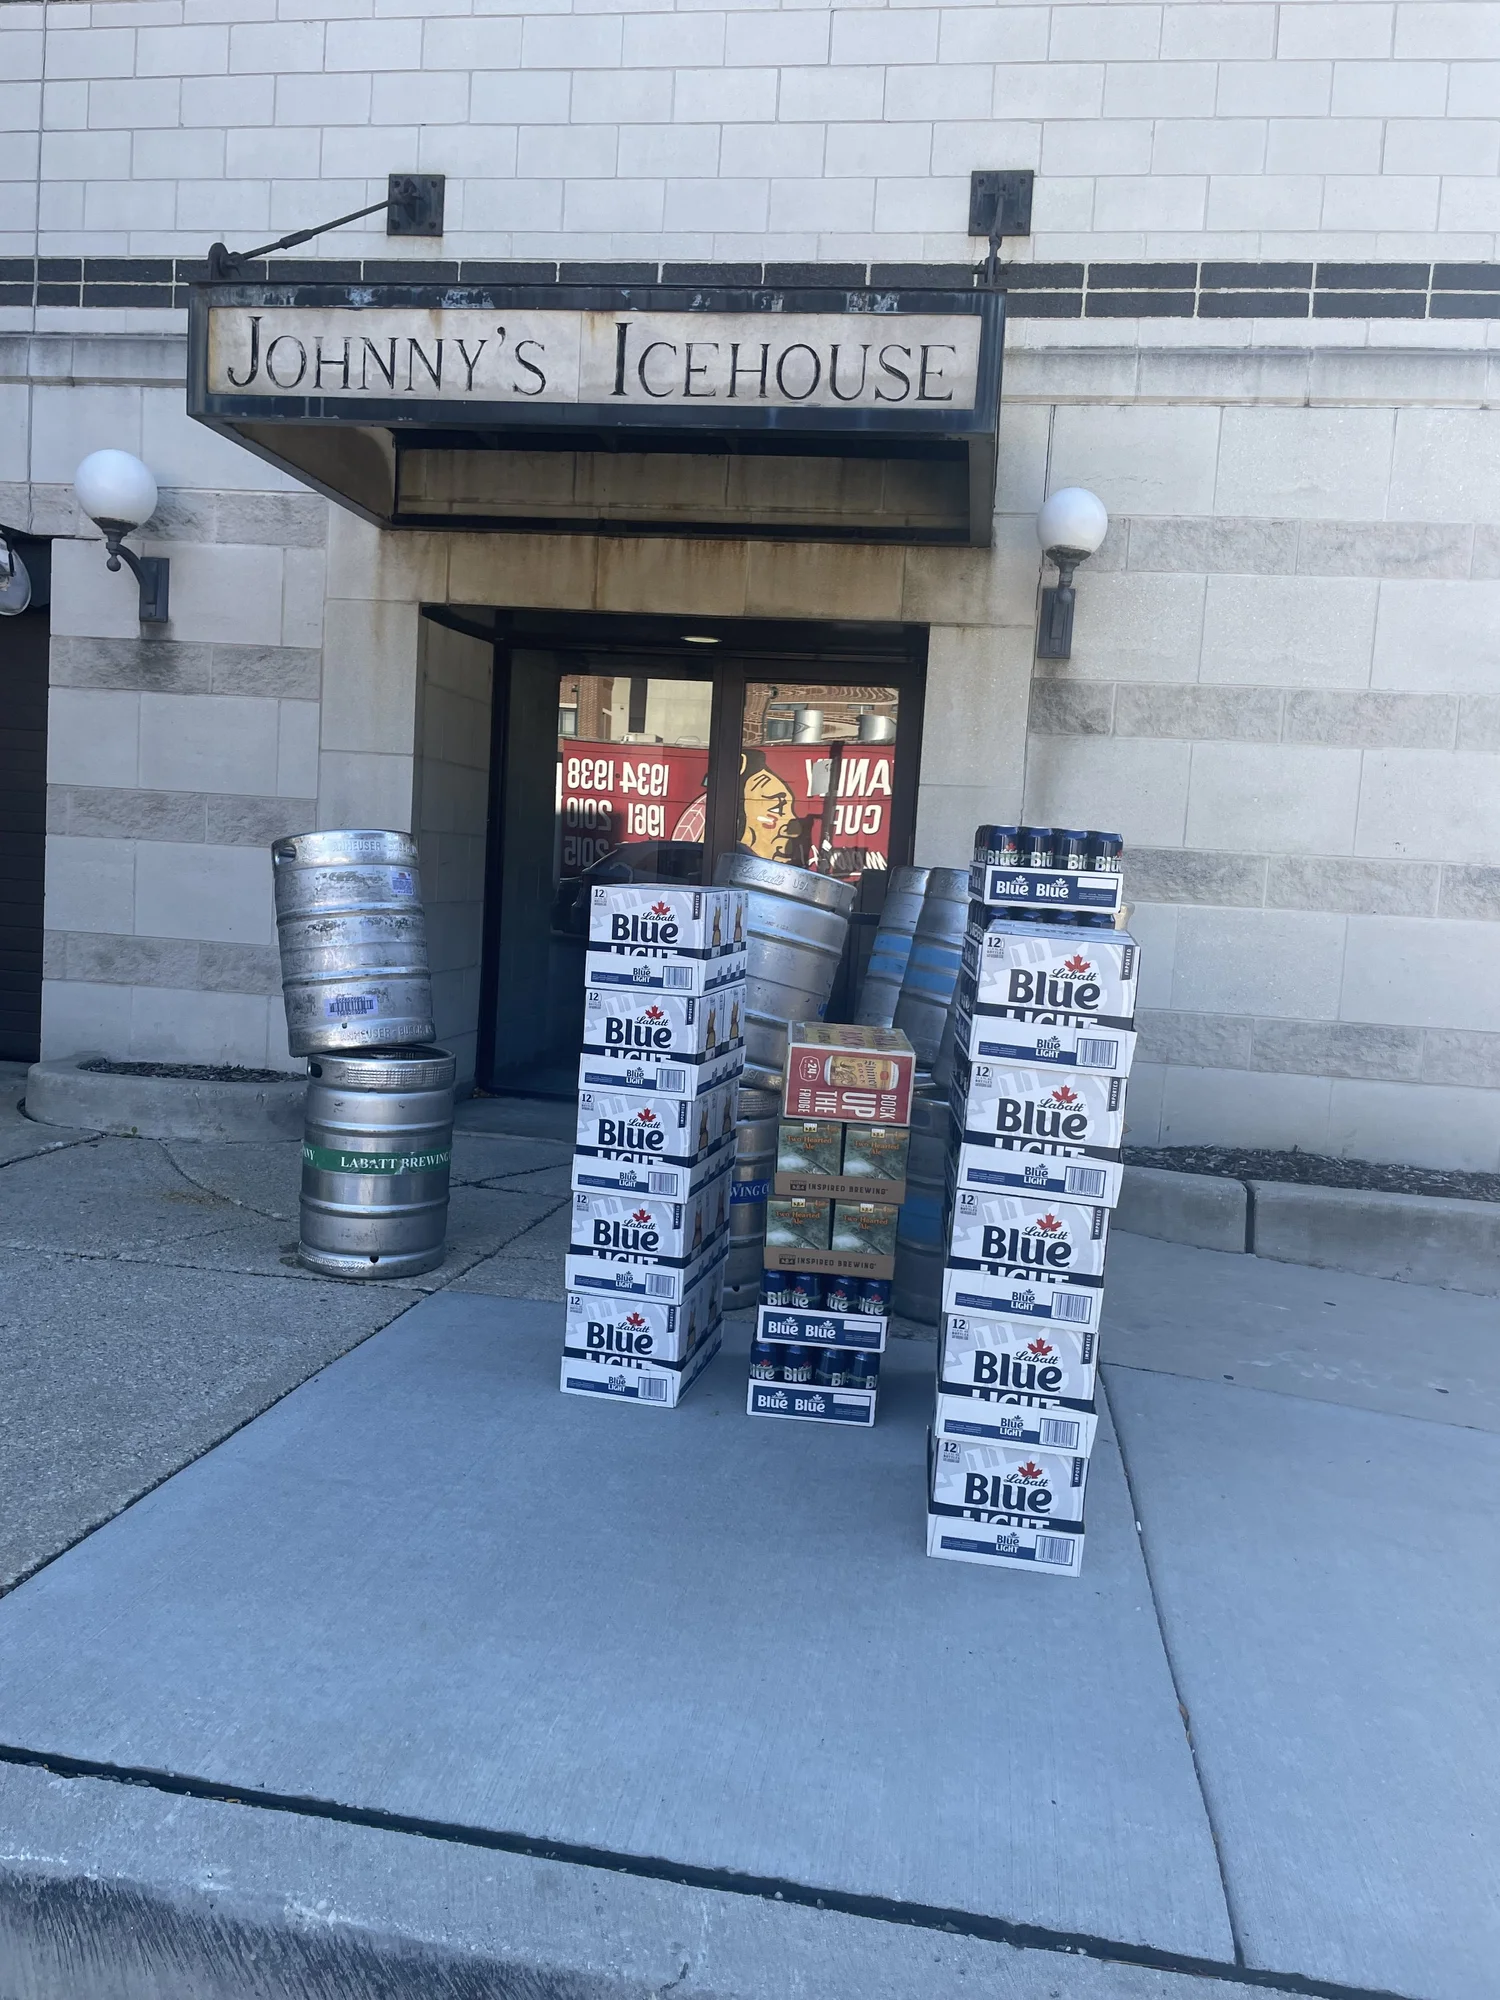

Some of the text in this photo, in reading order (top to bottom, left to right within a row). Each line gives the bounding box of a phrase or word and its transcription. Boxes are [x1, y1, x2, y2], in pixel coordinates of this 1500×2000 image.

[227, 315, 957, 402] JOHNNY'S ICEHOUSE
[1031, 851, 1053, 867] Blu
[594, 889, 604, 897] 12
[996, 881, 1029, 896] Blue
[1036, 883, 1069, 898] Blue
[641, 912, 675, 921] Labatt
[612, 914, 678, 944] Blue
[987, 937, 1001, 948] 12
[1124, 948, 1132, 976] IMPORTED
[633, 968, 650, 977] Blue
[1050, 968, 1097, 981] Labatt
[633, 975, 650, 983] LIGHT
[1008, 969, 1100, 1010] Blue
[589, 993, 598, 1001] 12
[634, 1016, 669, 1026] Labatt
[605, 1017, 672, 1048] Blue
[1037, 1039, 1060, 1050] Blue
[1036, 1049, 1059, 1059] LIGHT
[626, 1070, 644, 1078] Blue
[808, 1063, 817, 1074] 24
[976, 1067, 989, 1076] 12
[582, 1094, 592, 1102] 12
[798, 1089, 811, 1112] FRIDGE
[815, 1091, 837, 1113] THE
[842, 1092, 876, 1117] UP
[880, 1094, 897, 1119] BOCK
[1037, 1099, 1084, 1112] Labatt
[627, 1118, 661, 1128] Labatt
[997, 1098, 1087, 1140] Blue
[598, 1119, 664, 1150] Blue
[872, 1141, 899, 1150] Hearted
[340, 1156, 397, 1169] LABATT
[400, 1151, 449, 1168] BREWING
[620, 1172, 637, 1181] Blue
[1025, 1166, 1048, 1178] Blue
[1024, 1176, 1048, 1186] LIGHT
[849, 1186, 886, 1195] BREWING
[576, 1195, 587, 1203] 12
[960, 1194, 973, 1205] 12
[622, 1219, 656, 1230] Labatt
[860, 1216, 888, 1224] Hearted
[593, 1219, 659, 1251] Blue
[1022, 1227, 1068, 1240] Labatt
[982, 1225, 1071, 1268] Blue
[797, 1258, 834, 1266] INSPIRED
[838, 1260, 874, 1269] BREWING
[616, 1273, 633, 1282] Blue
[616, 1281, 633, 1289] LIGHT
[571, 1297, 580, 1305] 12
[1012, 1292, 1035, 1303] Blue
[1011, 1301, 1034, 1311] LIGHT
[616, 1323, 650, 1333] Labatt
[952, 1319, 966, 1329] 12
[768, 1321, 798, 1335] Blue
[805, 1325, 836, 1339] Blue
[587, 1322, 653, 1355] Blue
[1013, 1352, 1059, 1365] Labatt
[973, 1351, 1062, 1392] Blue
[608, 1376, 626, 1385] Blue
[608, 1384, 626, 1392] LIGHT
[758, 1395, 788, 1409] Blue
[795, 1398, 825, 1413] Blue
[1001, 1418, 1023, 1429] Blue
[1000, 1427, 1023, 1437] LIGHT
[944, 1442, 957, 1453] 12
[1004, 1474, 1048, 1486] Labatt
[964, 1473, 1052, 1513] Blue
[997, 1535, 1019, 1546] Blue
[996, 1543, 1019, 1553] LIGHT
